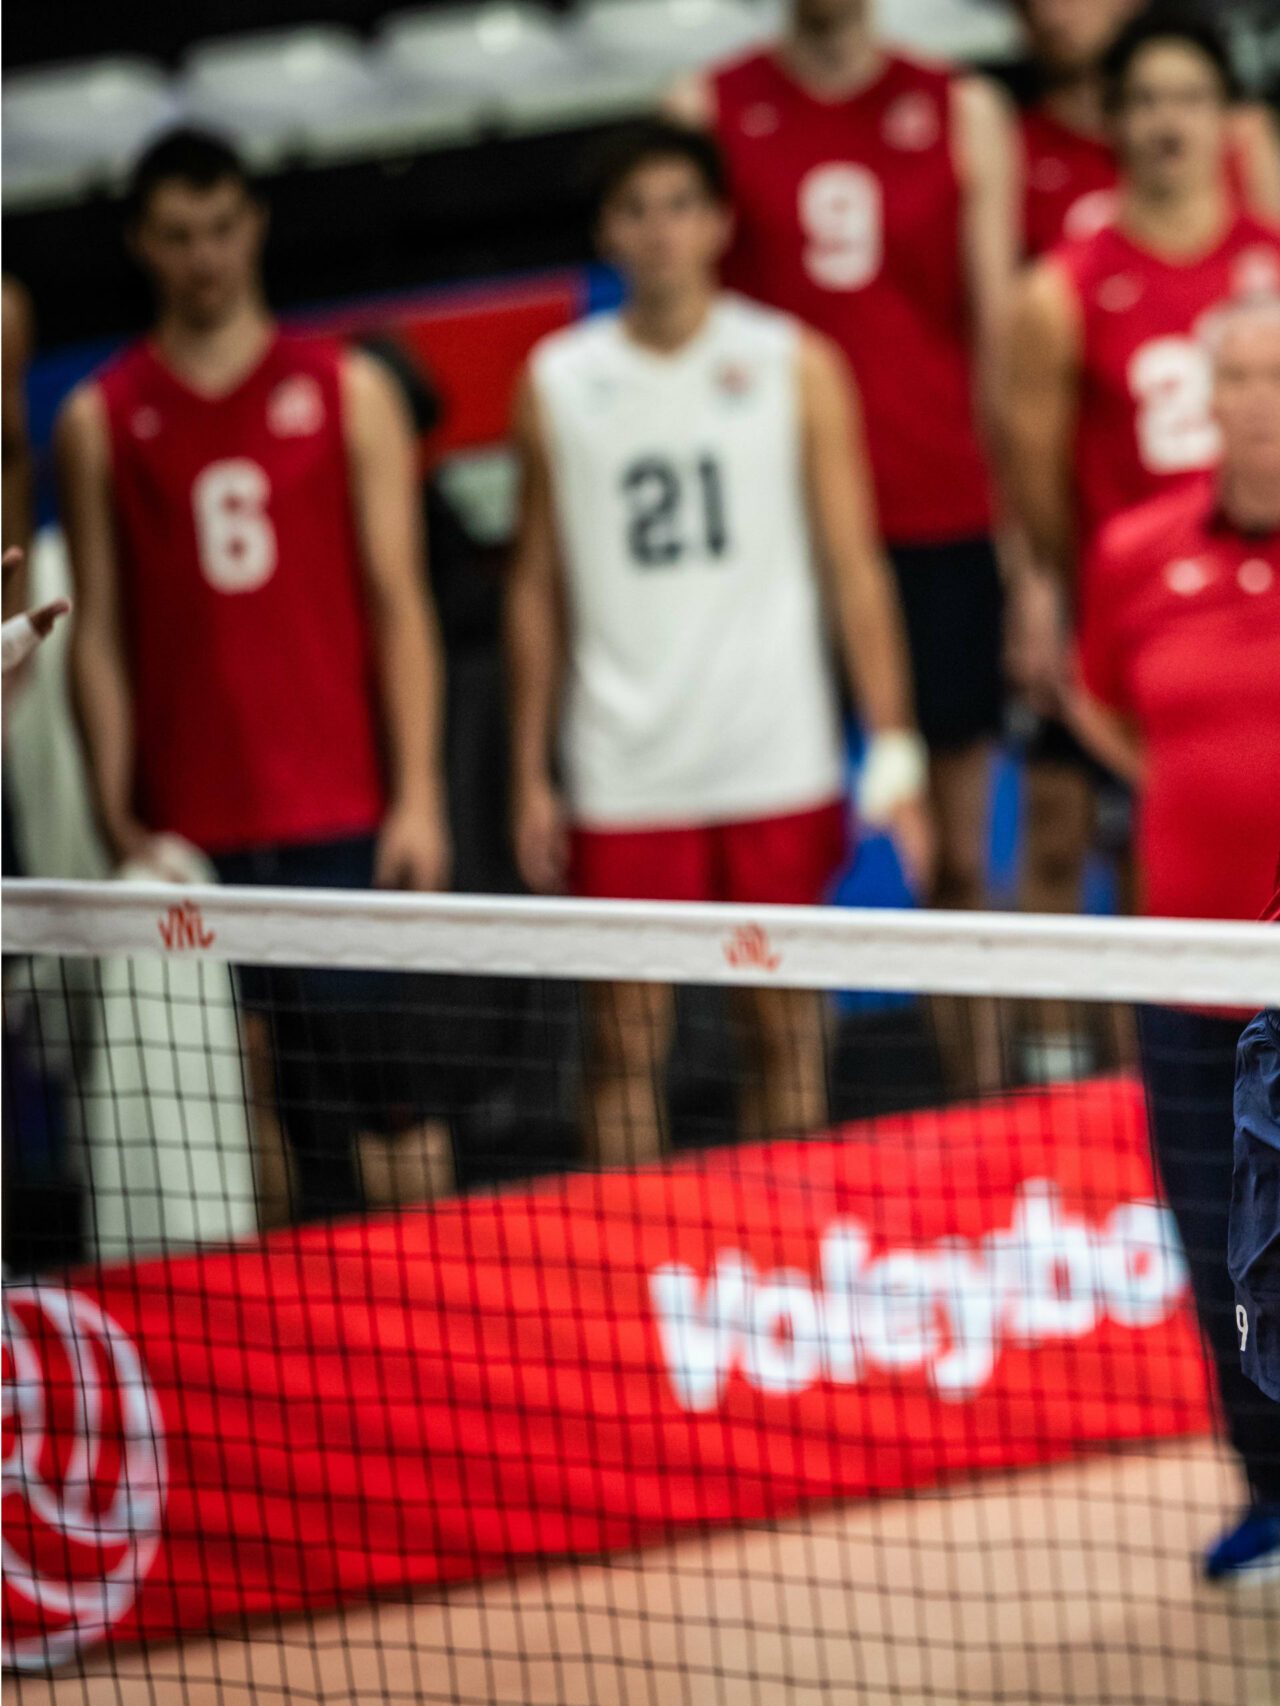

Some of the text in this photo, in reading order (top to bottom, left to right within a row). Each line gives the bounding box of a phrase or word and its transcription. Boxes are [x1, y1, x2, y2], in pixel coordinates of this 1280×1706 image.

[798, 162, 883, 292] 9
[192, 457, 277, 593] 6
[621, 448, 726, 568] 21
[1236, 1304, 1249, 1352] 9
